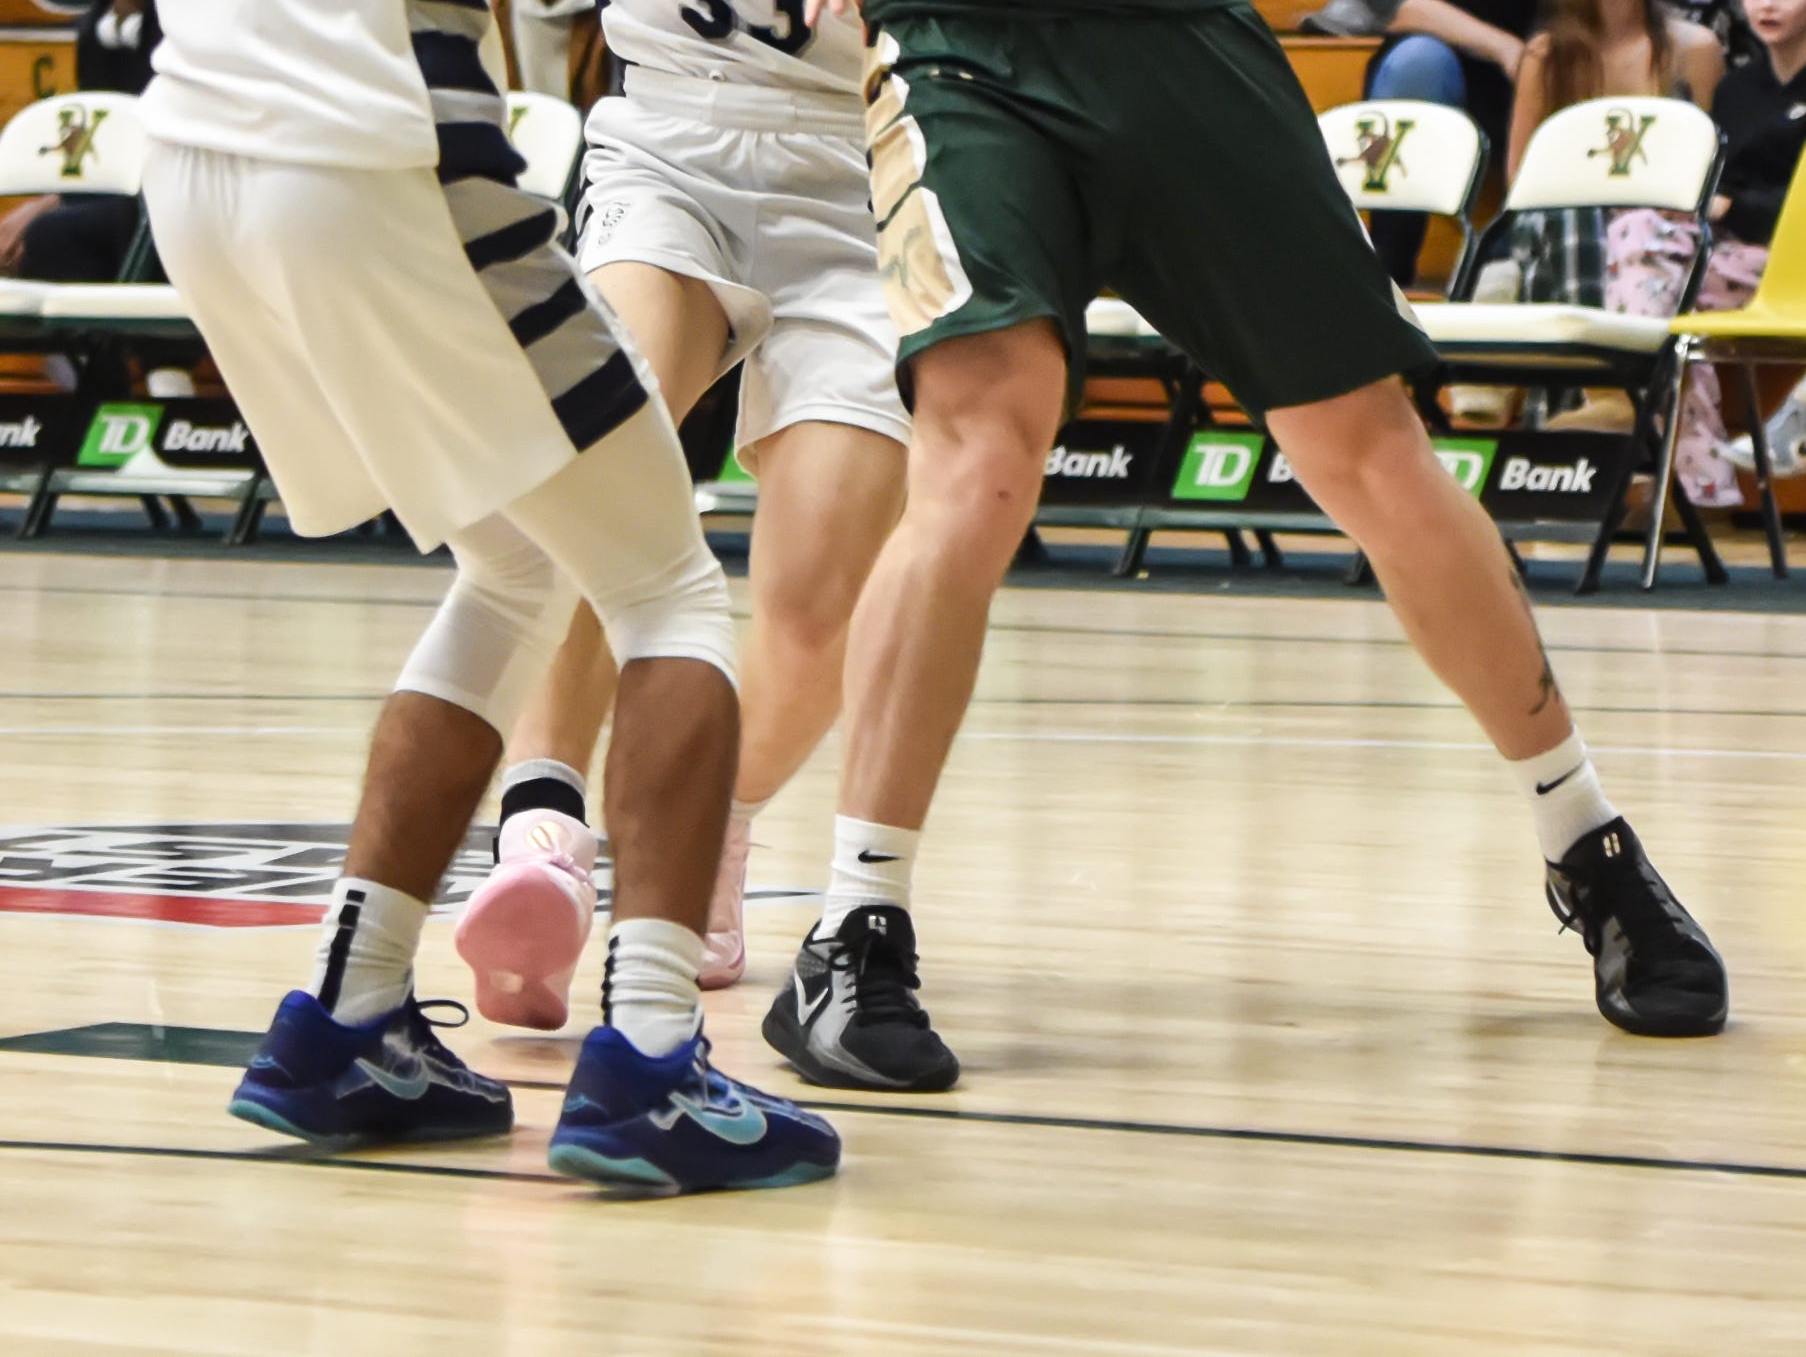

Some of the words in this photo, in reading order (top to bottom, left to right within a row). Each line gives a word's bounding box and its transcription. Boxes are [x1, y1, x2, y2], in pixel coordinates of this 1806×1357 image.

[99, 413, 150, 454] TD
[163, 418, 250, 453] Bank
[1194, 444, 1252, 486] TD
[1499, 457, 1597, 493] Bank
